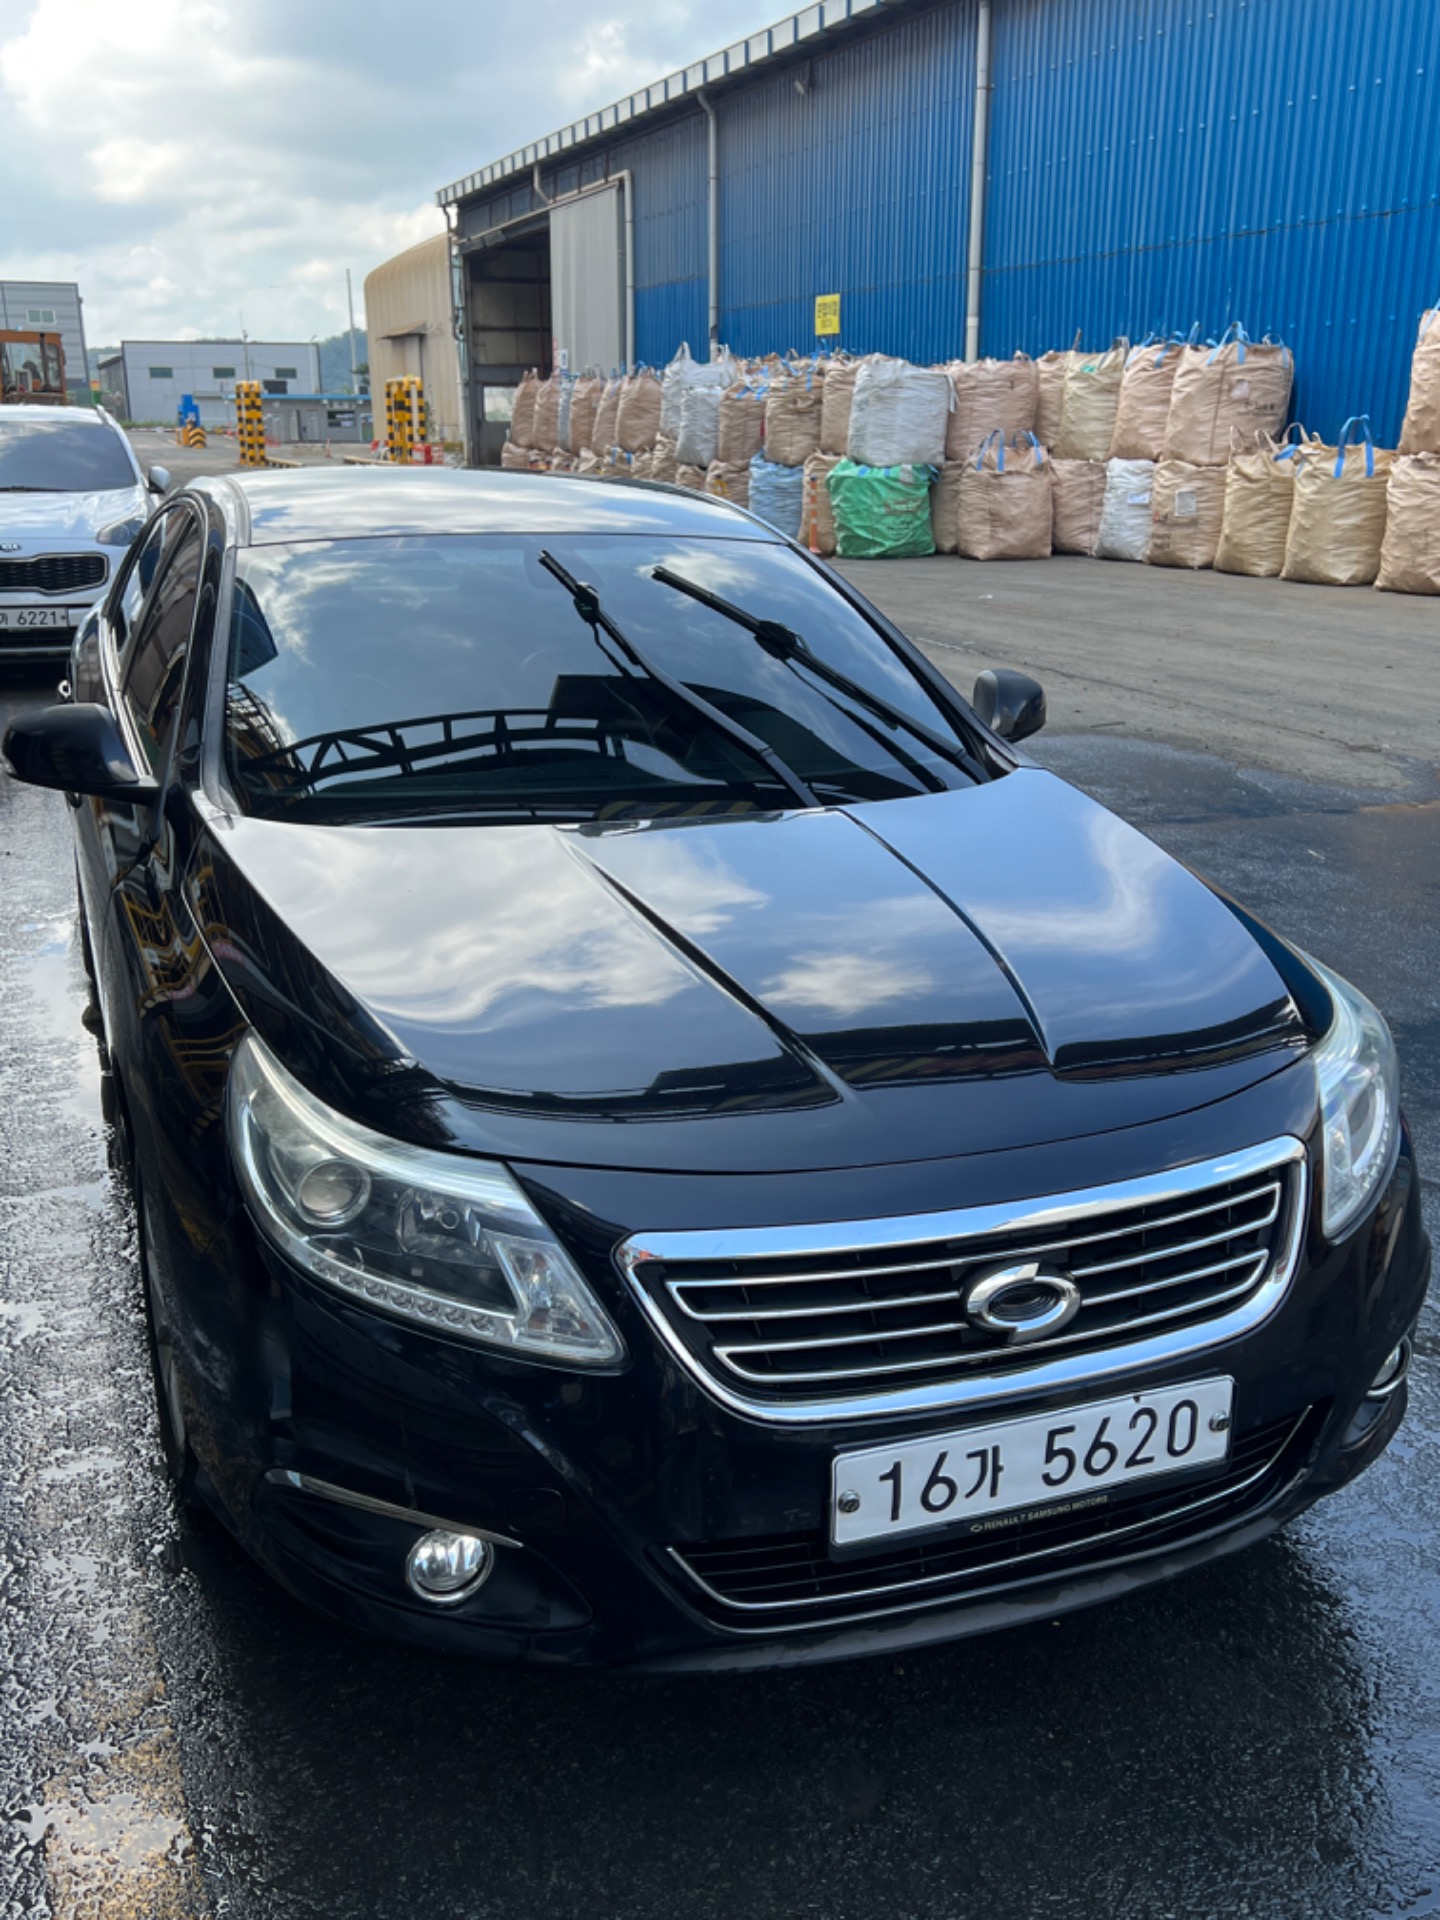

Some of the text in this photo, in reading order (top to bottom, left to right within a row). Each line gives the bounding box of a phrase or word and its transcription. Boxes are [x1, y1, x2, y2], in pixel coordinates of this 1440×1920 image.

[16, 610, 57, 626] 6221
[878, 1398, 1200, 1522] 16가 5620
